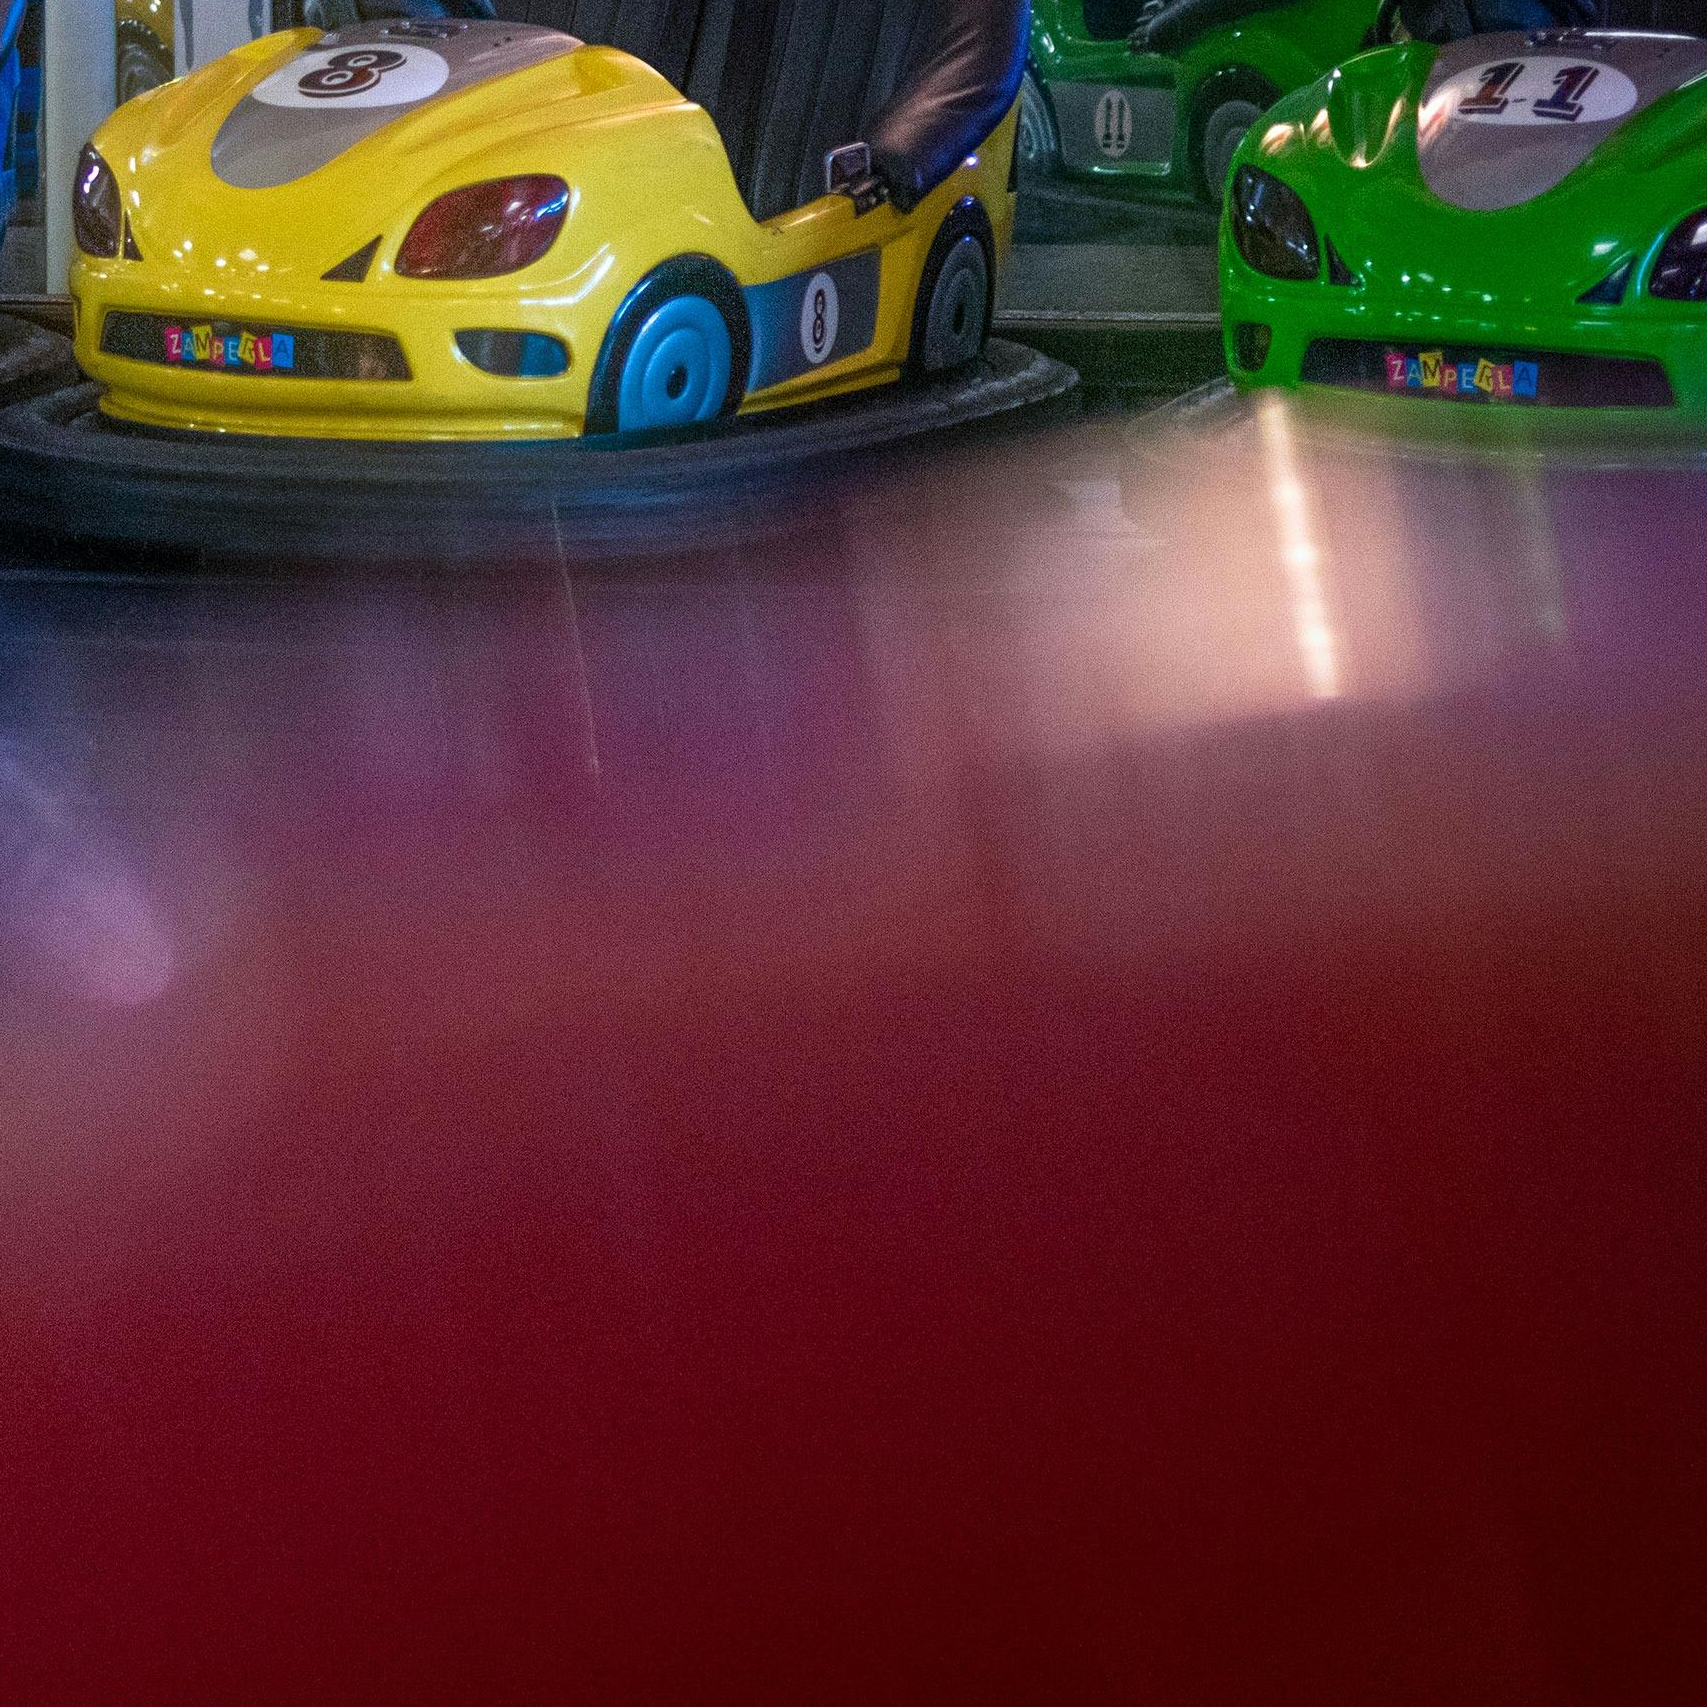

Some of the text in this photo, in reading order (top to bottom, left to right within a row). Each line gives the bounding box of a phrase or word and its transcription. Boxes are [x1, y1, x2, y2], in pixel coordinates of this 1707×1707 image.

[298, 49, 408, 99] 8
[812, 288, 825, 354] 8
[166, 328, 292, 366] ZAMPERLA
[1389, 354, 1537, 394] ZAMPERLA
